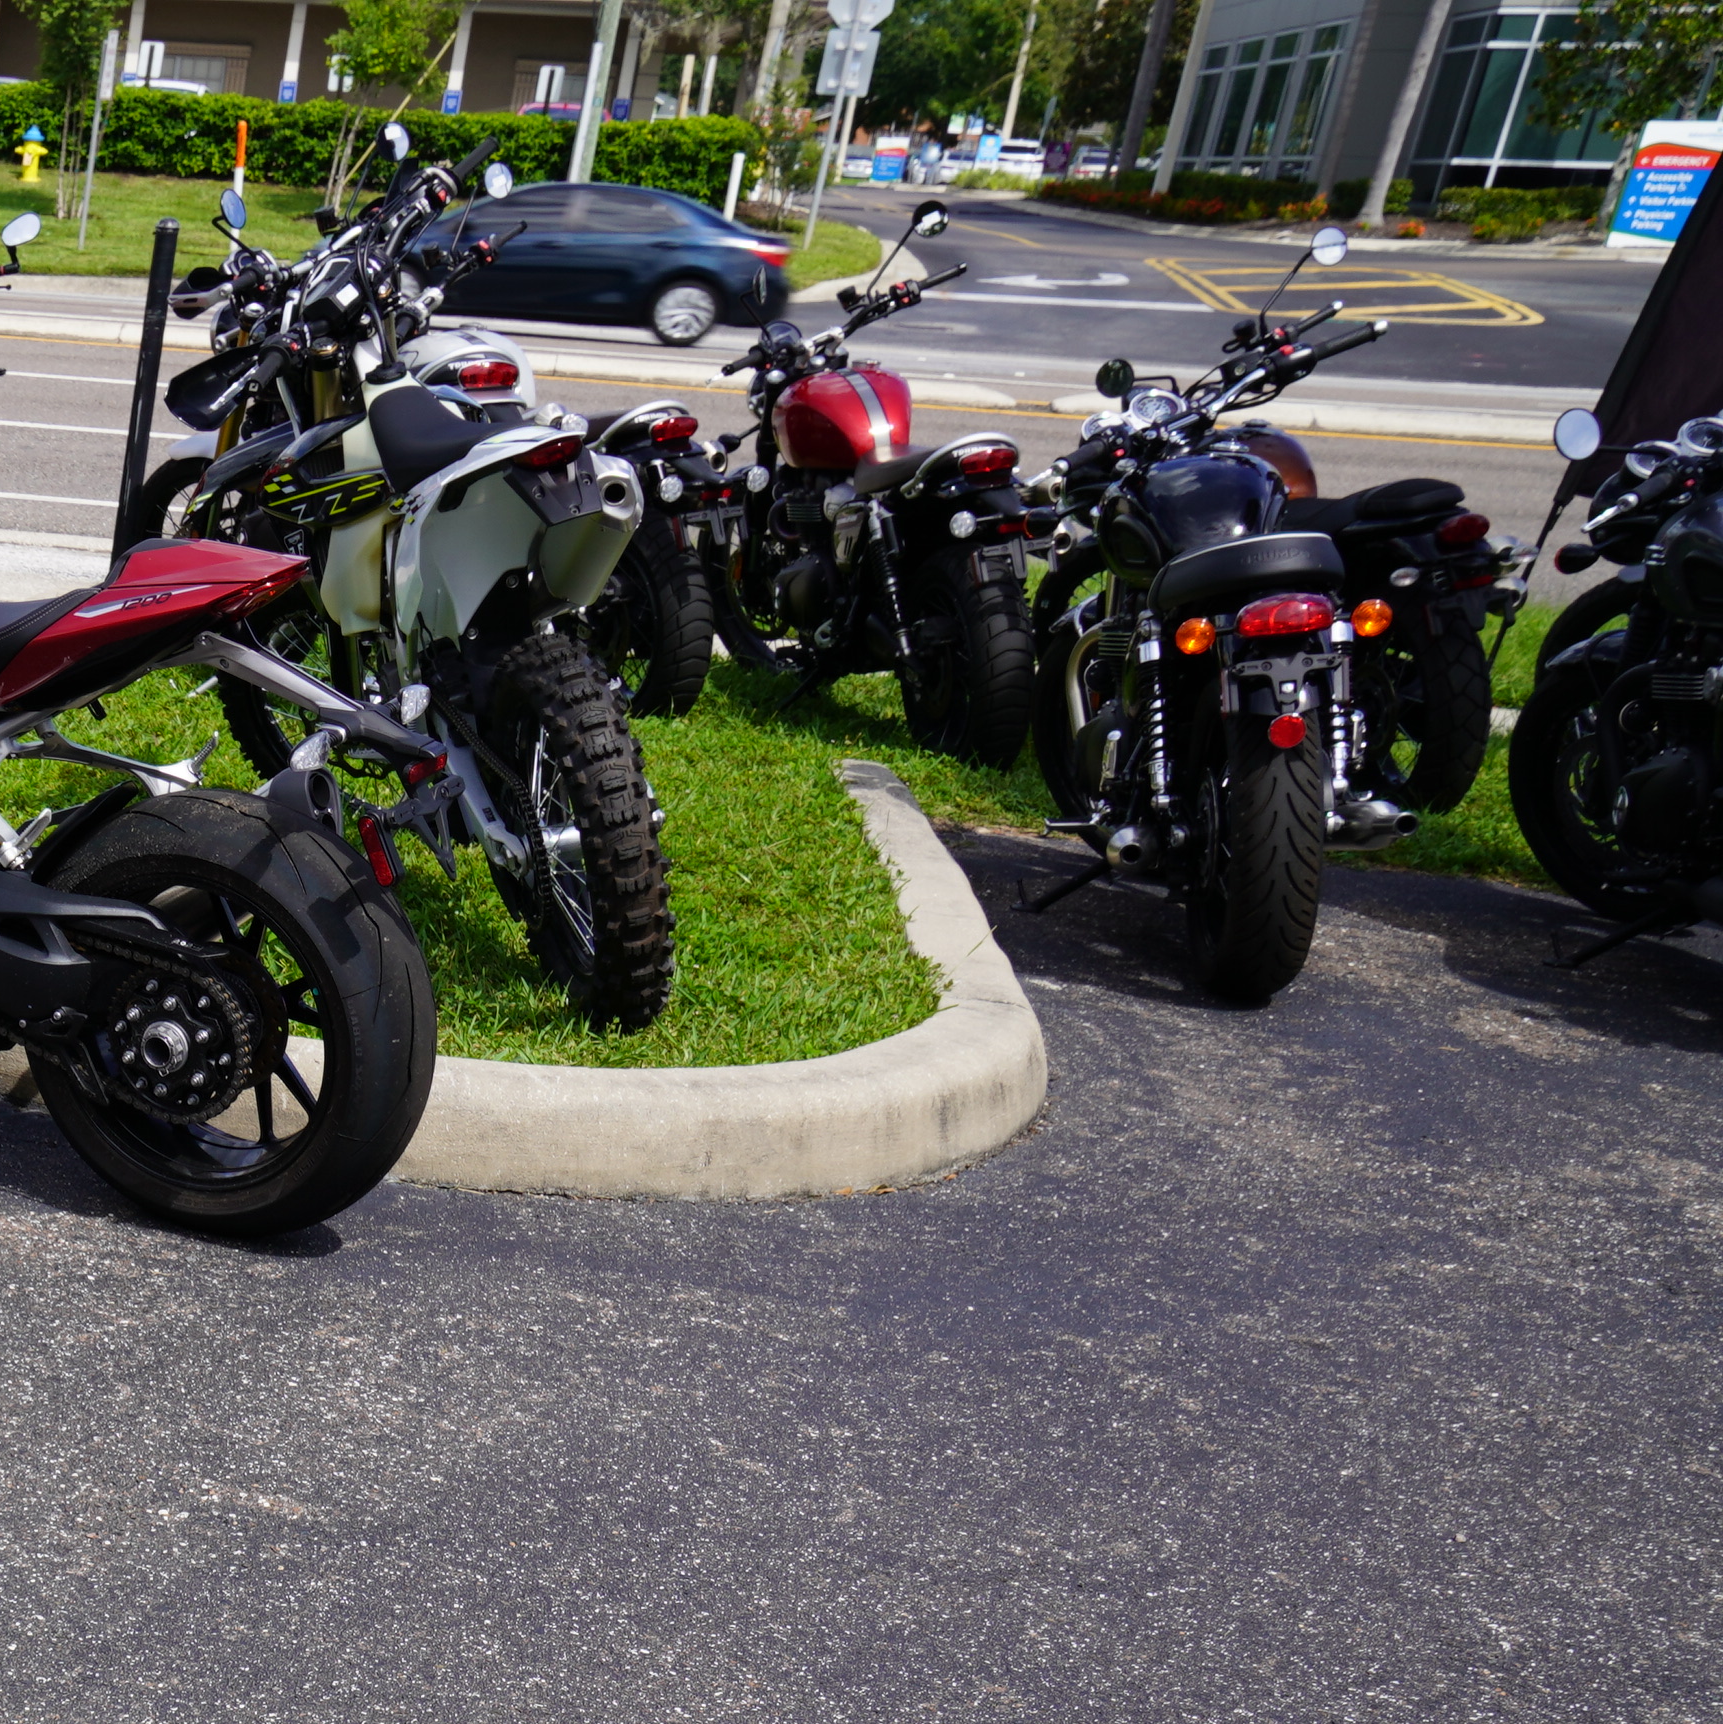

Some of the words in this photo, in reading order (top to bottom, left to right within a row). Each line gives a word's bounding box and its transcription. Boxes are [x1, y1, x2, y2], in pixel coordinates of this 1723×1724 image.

[1652, 155, 1712, 167] EMERGENCY
[1646, 171, 1694, 183] Accessible
[1643, 182, 1677, 194] Parking
[1667, 195, 1698, 207] Parkin
[1630, 219, 1664, 232] Parking
[121, 591, 172, 611] 1200
